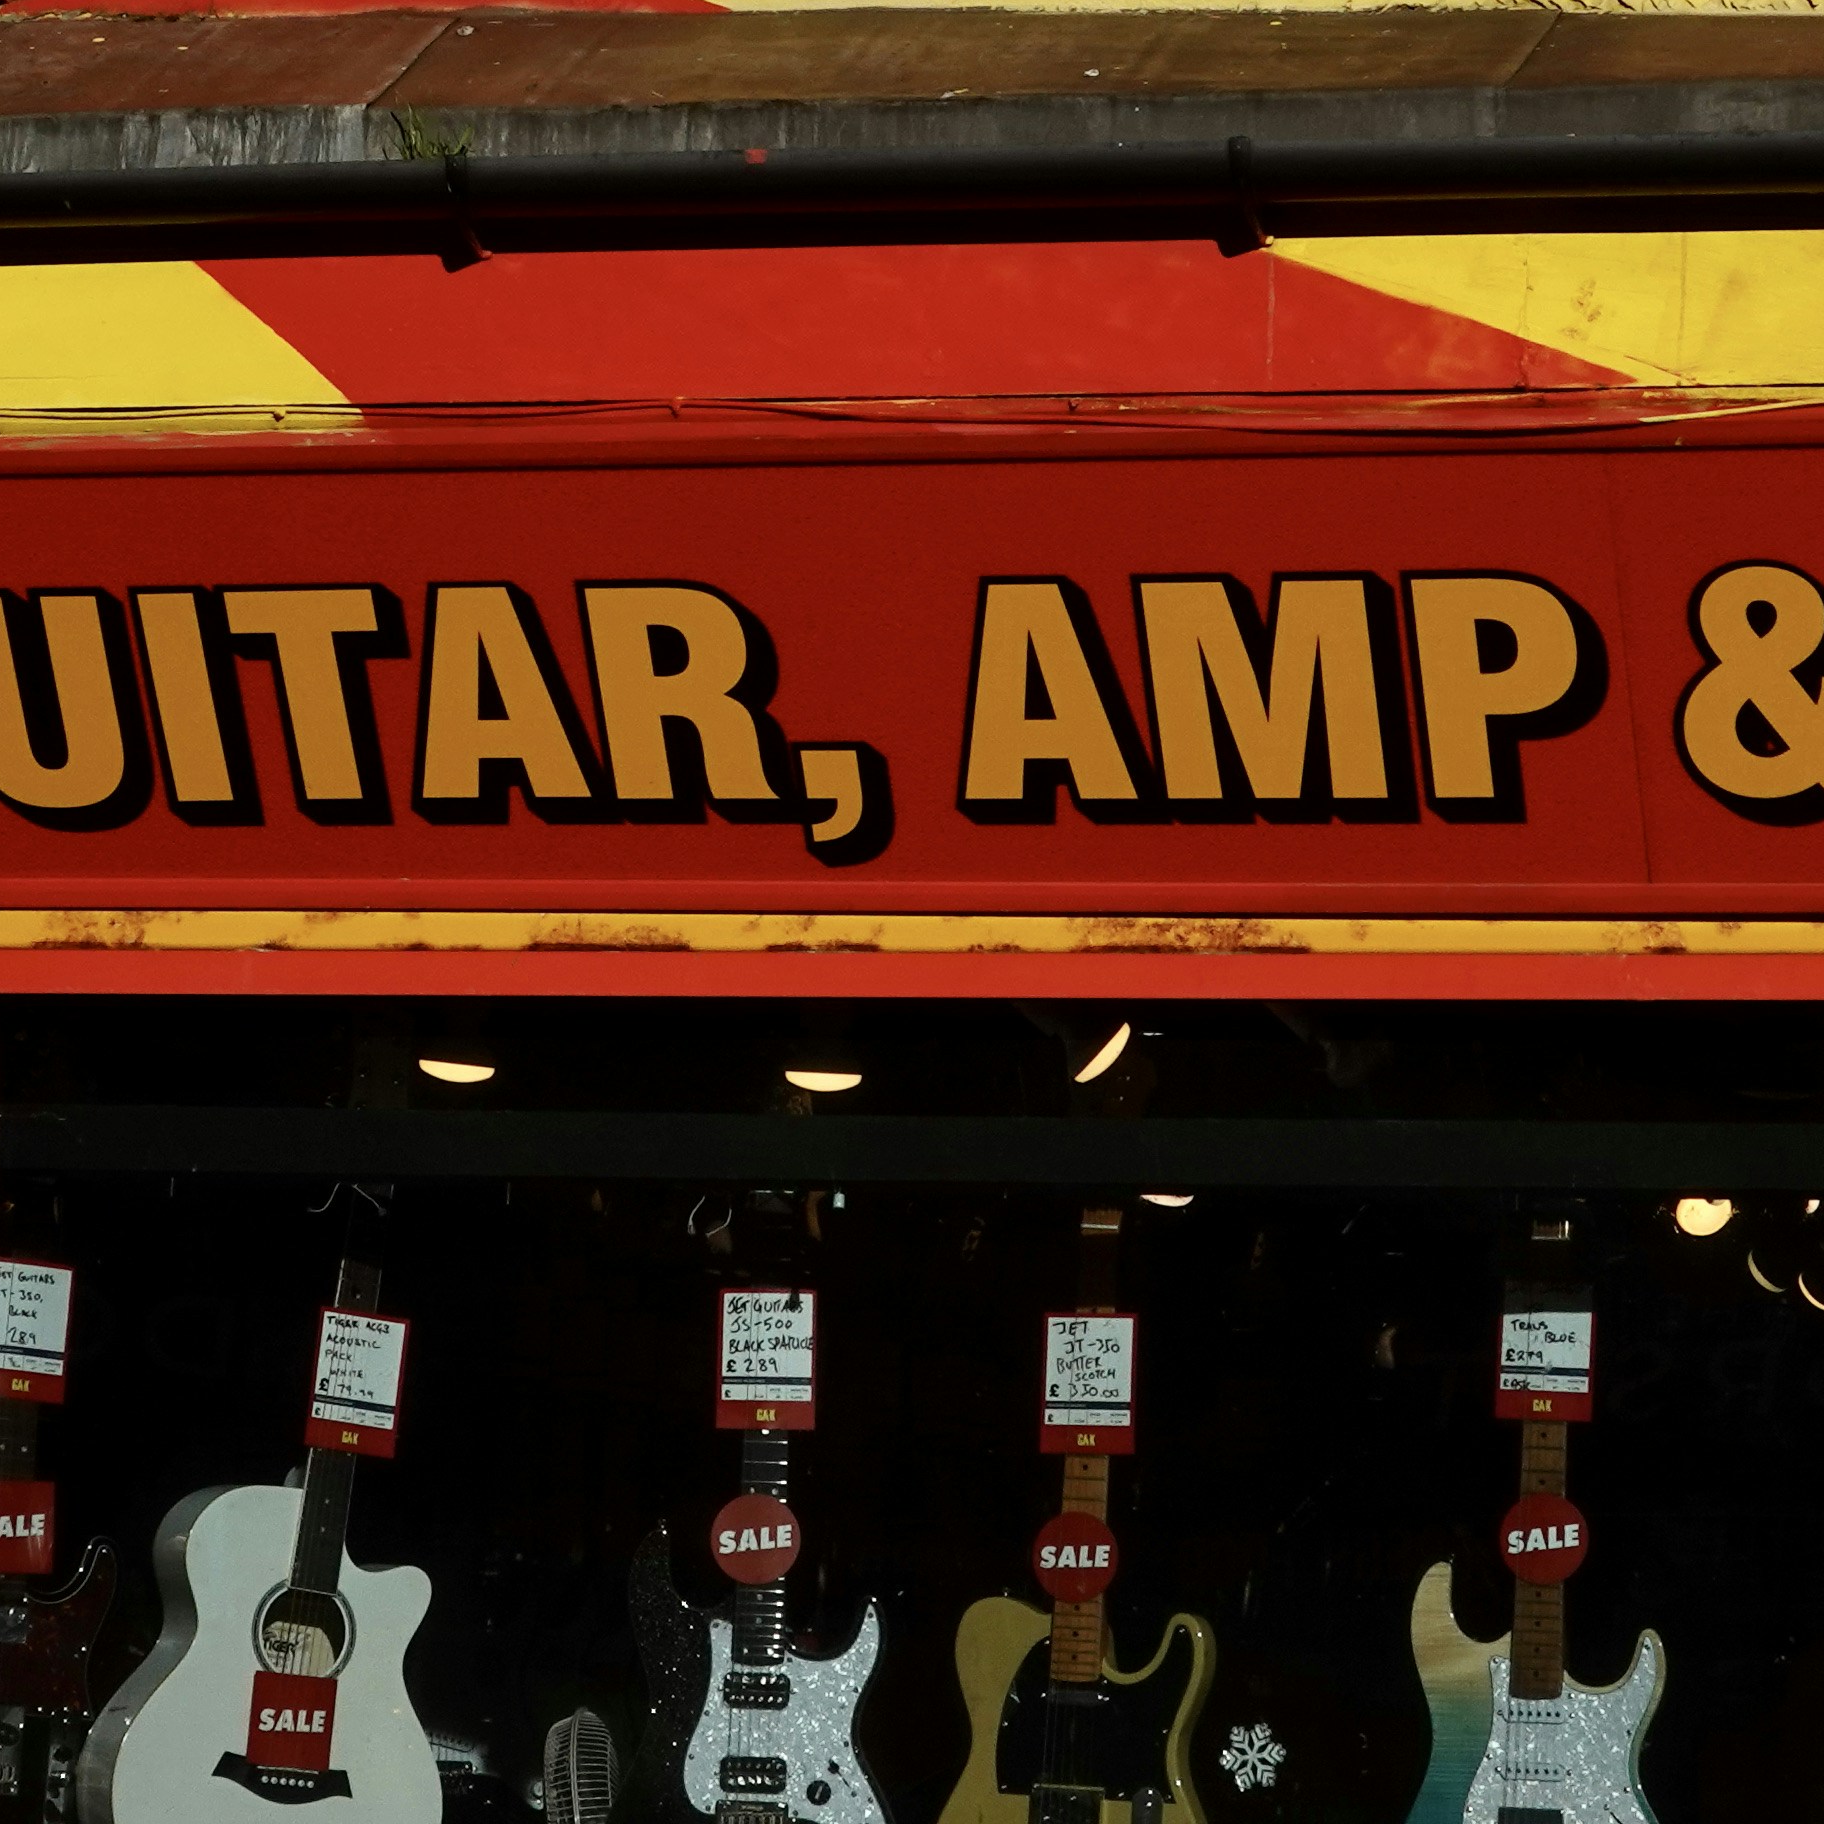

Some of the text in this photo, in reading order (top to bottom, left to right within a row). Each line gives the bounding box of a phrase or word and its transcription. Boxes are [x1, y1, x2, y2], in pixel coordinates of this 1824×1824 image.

[962, 578, 1592, 806] AMP
[325, 1333, 382, 1349] ACOUSTIC
[1544, 1331, 1577, 1344] BLUE
[729, 1338, 766, 1354] BLACK
[325, 1349, 352, 1363] PACK
[726, 1358, 779, 1373] £ 289
[1056, 1356, 1103, 1374] BUTTER
[1075, 1368, 1117, 1382] SCOTCH
[11, 1378, 31, 1393] GAK
[318, 1377, 329, 1392] £
[1049, 1383, 1060, 1397] £
[1532, 1399, 1553, 1412] GAK
[756, 1408, 776, 1422] GAK
[341, 1430, 360, 1446] GAK
[1076, 1433, 1096, 1446] GAK
[719, 1524, 793, 1554] SALE
[1507, 1523, 1580, 1554] SALE
[1039, 1544, 1111, 1569] SALE
[258, 1707, 327, 1734] SALE
